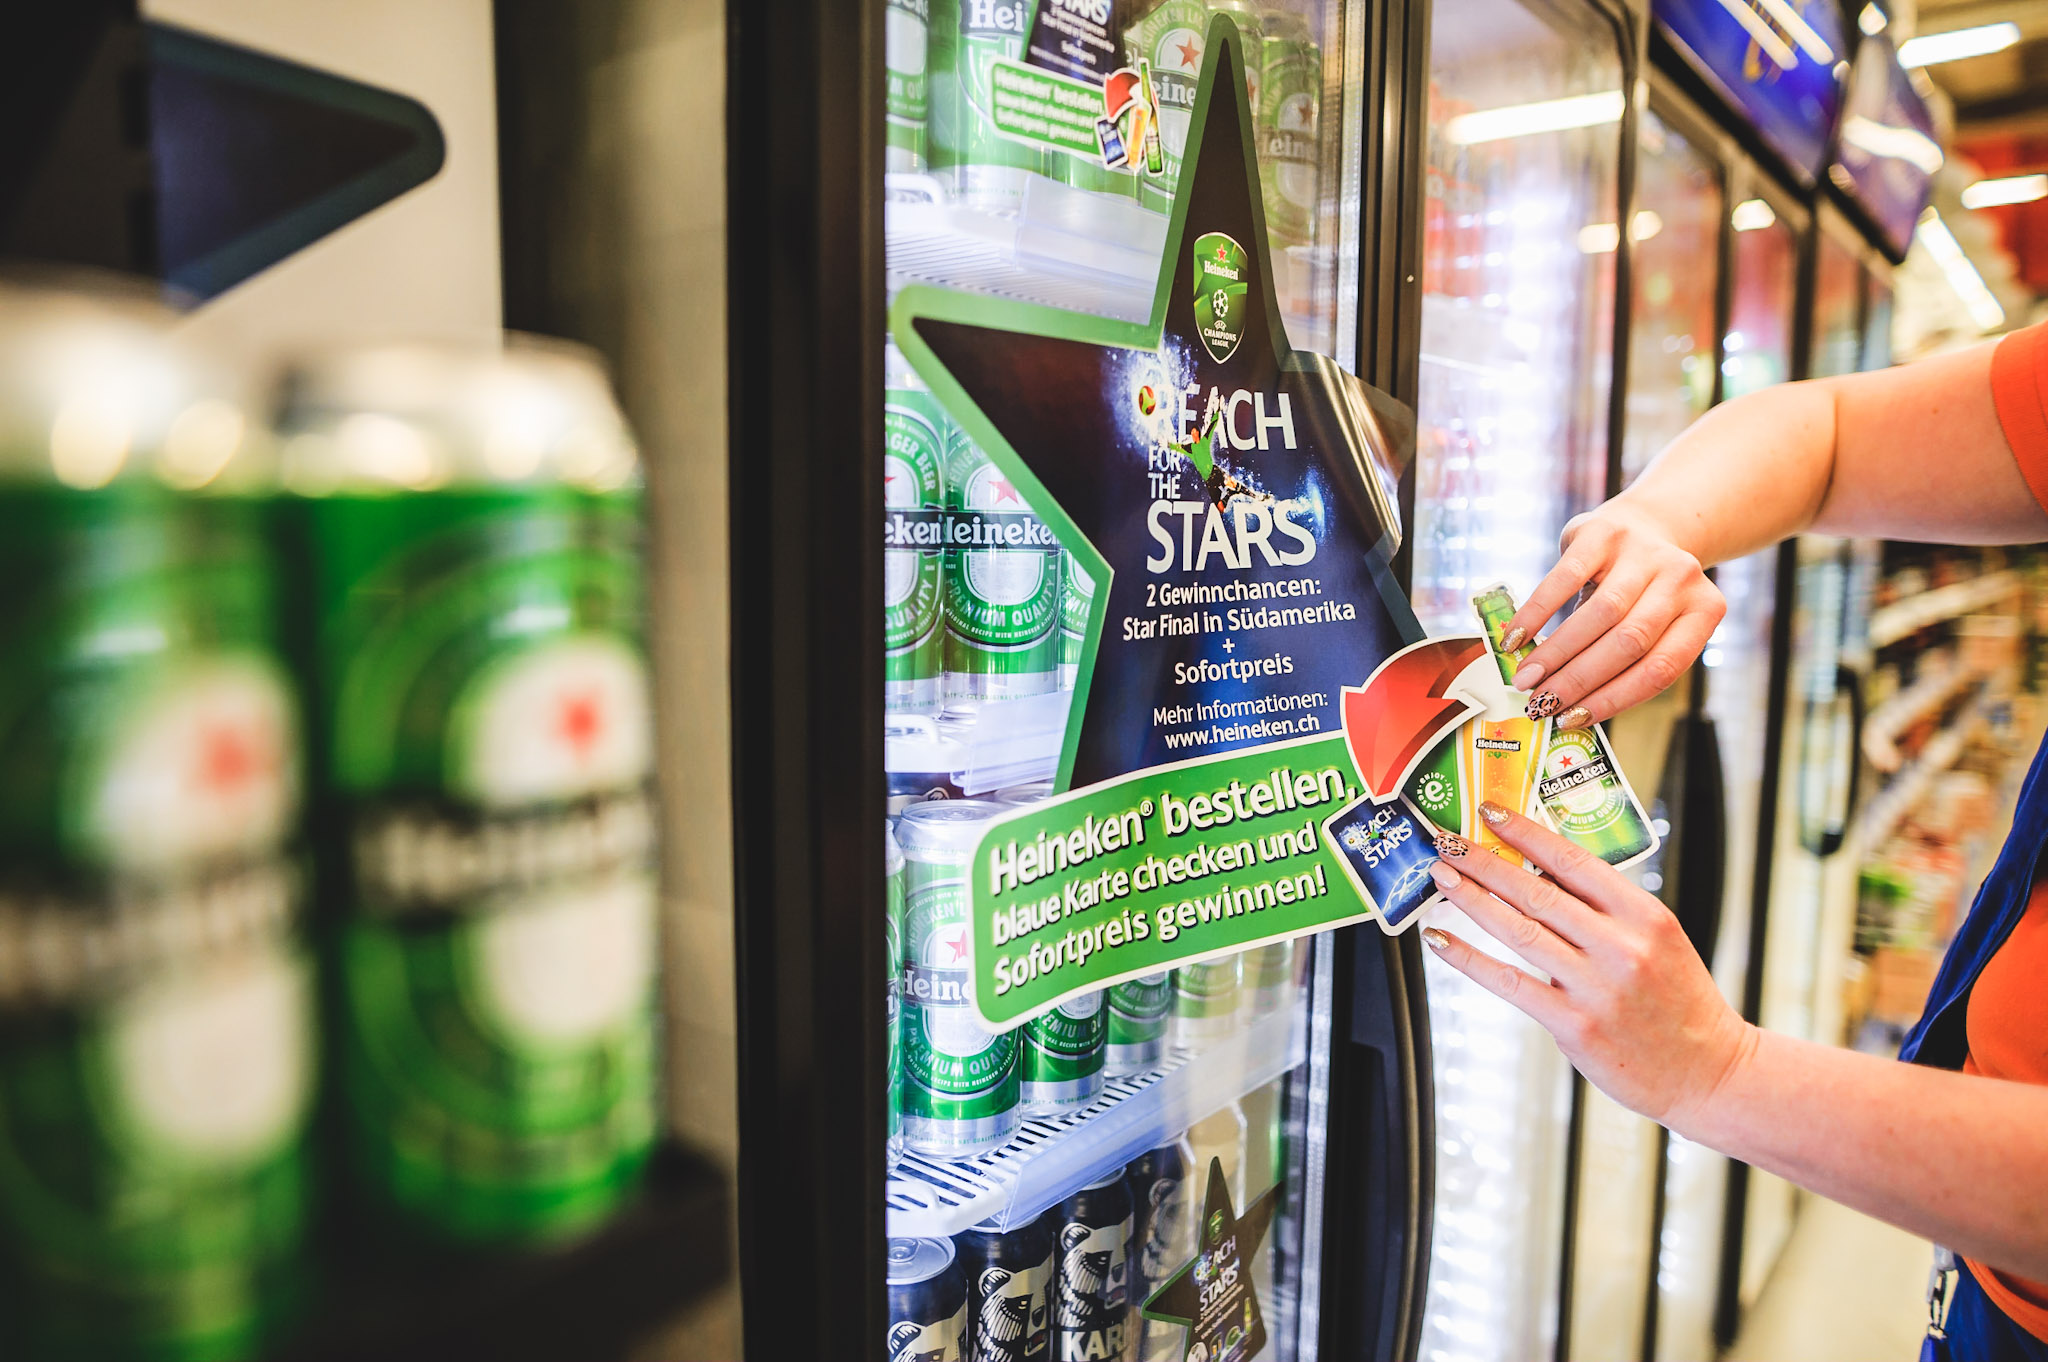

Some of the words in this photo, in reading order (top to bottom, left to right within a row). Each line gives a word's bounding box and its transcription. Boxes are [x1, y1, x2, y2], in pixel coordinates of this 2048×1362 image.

[968, 0, 1026, 32] Hei
[1203, 327, 1237, 343] CHAMPIONS
[1149, 383, 1297, 451] REACH
[886, 432, 919, 459] GER
[1148, 446, 1181, 473] FOR
[1148, 473, 1181, 499] THE
[1146, 499, 1317, 574] STARS
[948, 577, 1006, 627] PREMIUM
[1011, 578, 1055, 626] QUALITY
[1146, 584, 1157, 608] 2
[1159, 577, 1322, 607] Gewinnchancen:
[1122, 612, 1156, 642] Star
[1159, 609, 1200, 638] Final
[1203, 611, 1224, 634] in
[1226, 599, 1357, 632] Südamerika
[1222, 638, 1236, 655] +
[1174, 652, 1294, 685] Sofortpreis
[1153, 702, 1194, 727] Mehr
[1197, 691, 1329, 722] Informationen:
[1165, 713, 1321, 750] www.heineken.ch
[1477, 739, 1520, 750] Heineken
[1540, 760, 1609, 798] Heineken
[1160, 767, 1358, 837] bestellen,
[1364, 821, 1413, 869] STARS
[991, 893, 1062, 948] blaue
[1063, 869, 1131, 918] Karte
[1131, 843, 1256, 892] checken
[1257, 820, 1319, 863] und
[993, 908, 1151, 997] Sofortpreis
[1155, 863, 1329, 943] gewinnen!
